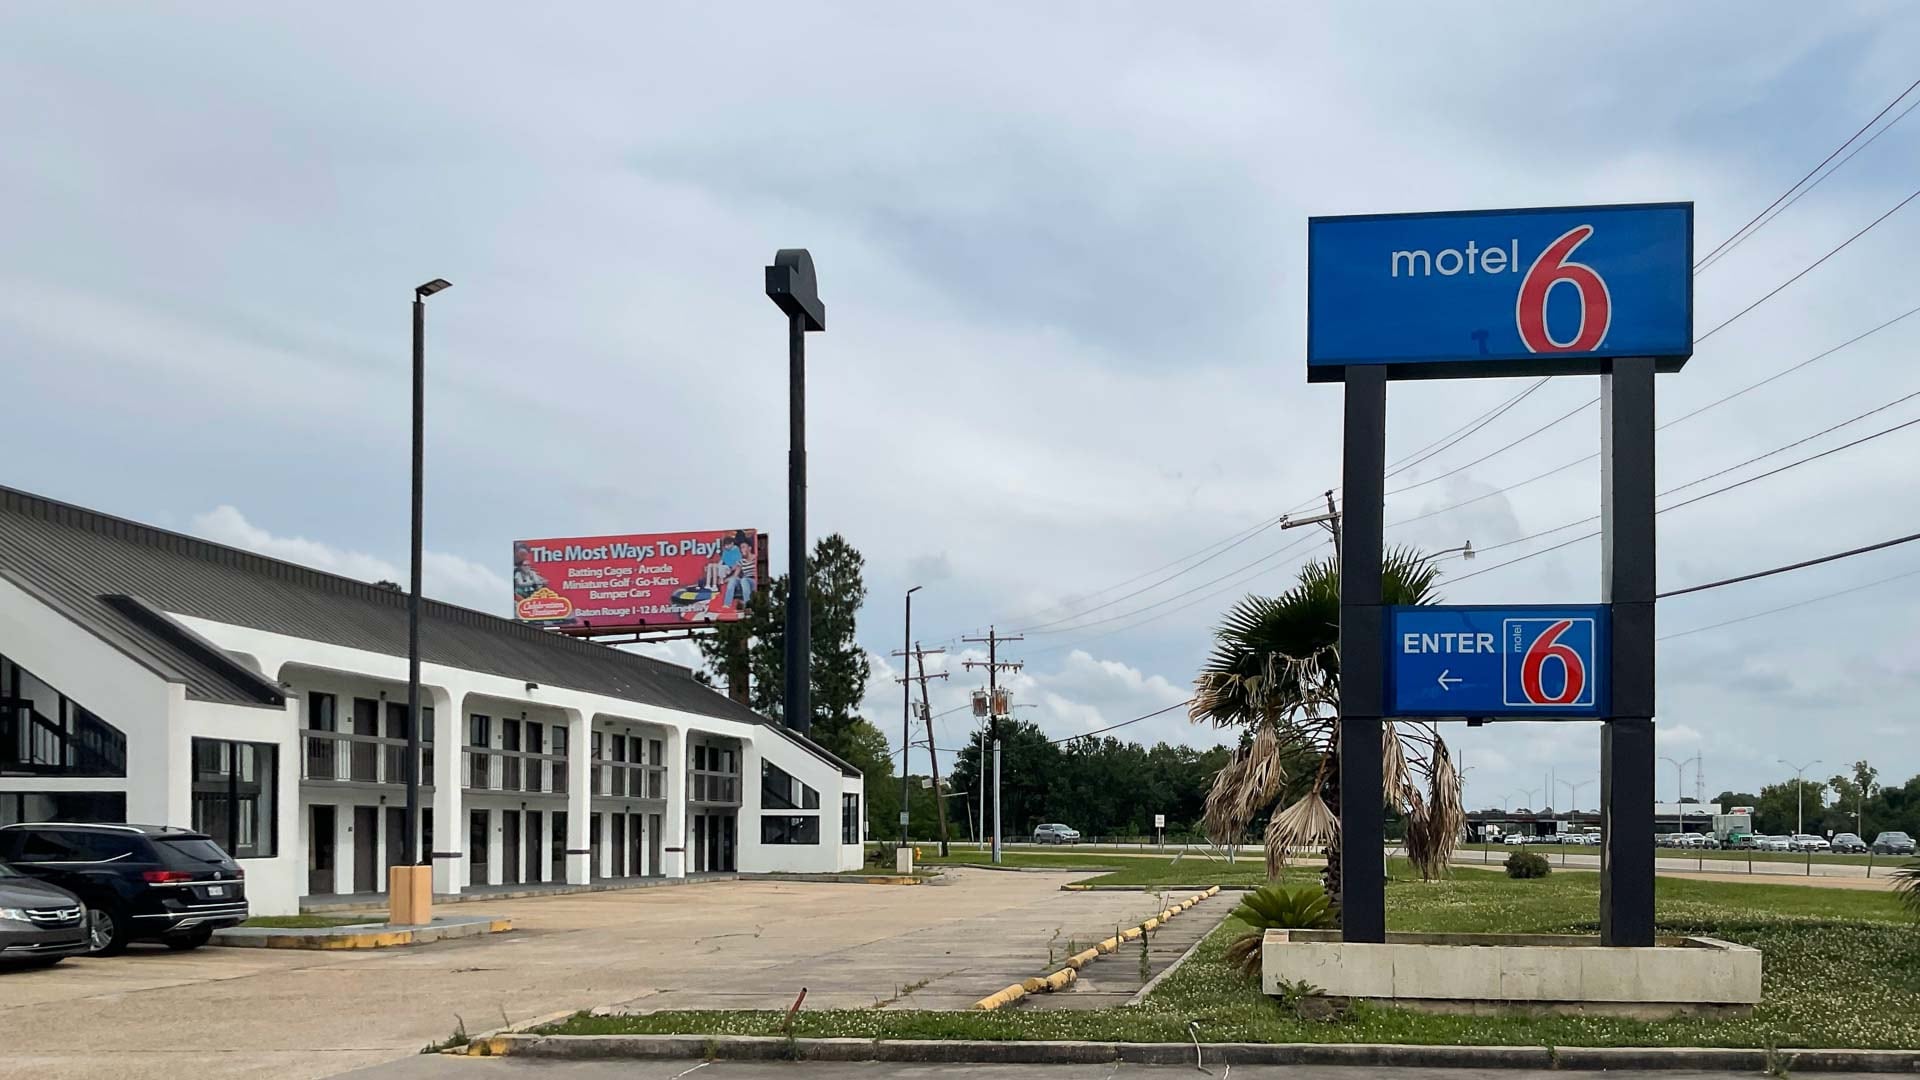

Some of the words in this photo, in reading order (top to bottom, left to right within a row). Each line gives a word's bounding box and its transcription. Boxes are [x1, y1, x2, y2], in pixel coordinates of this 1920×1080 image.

[1391, 238, 1518, 277] motel
[1515, 224, 1612, 354] 6
[532, 547, 562, 562] The
[565, 545, 607, 561] Most
[610, 542, 655, 562] Ways
[658, 541, 678, 557] To
[680, 538, 721, 560] Play!
[568, 567, 603, 578] Batting
[604, 566, 632, 577] Cages
[639, 564, 673, 574] Arcade
[563, 579, 609, 590] Miniature
[609, 577, 631, 588] Golf
[635, 576, 679, 587] Go-Karts
[589, 590, 629, 600] Bumper
[630, 588, 651, 598] Cars
[574, 608, 601, 617] Baton
[602, 607, 630, 616] Rouge
[1403, 633, 1495, 654] ENTER
[1513, 624, 1522, 653] motel
[1521, 619, 1586, 704] 6
